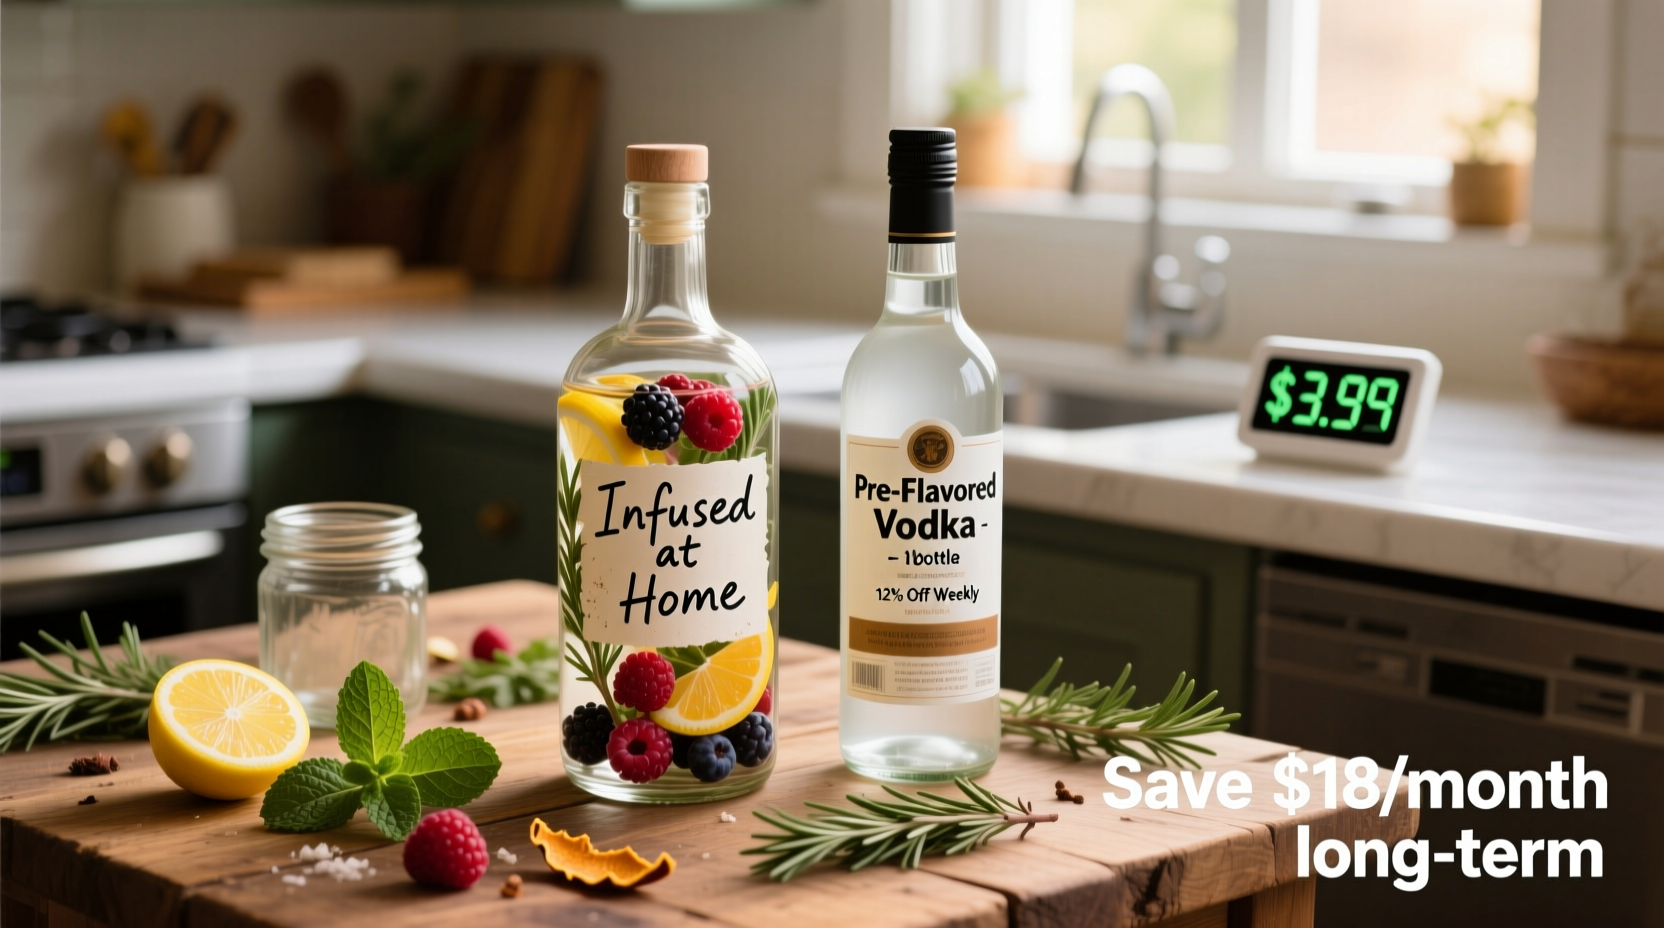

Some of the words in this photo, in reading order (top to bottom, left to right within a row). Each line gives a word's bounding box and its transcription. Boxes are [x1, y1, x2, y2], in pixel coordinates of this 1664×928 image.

[1264, 365, 1399, 432] $3.99
[855, 471, 996, 503] Pre-Flavored
[594, 473, 756, 547] Infused
[873, 508, 976, 540] Vodka
[656, 534, 701, 568] at
[619, 571, 746, 625] Home
[876, 587, 904, 602] 12%
[906, 587, 931, 602] Off
[933, 585, 980, 604] Weekly
